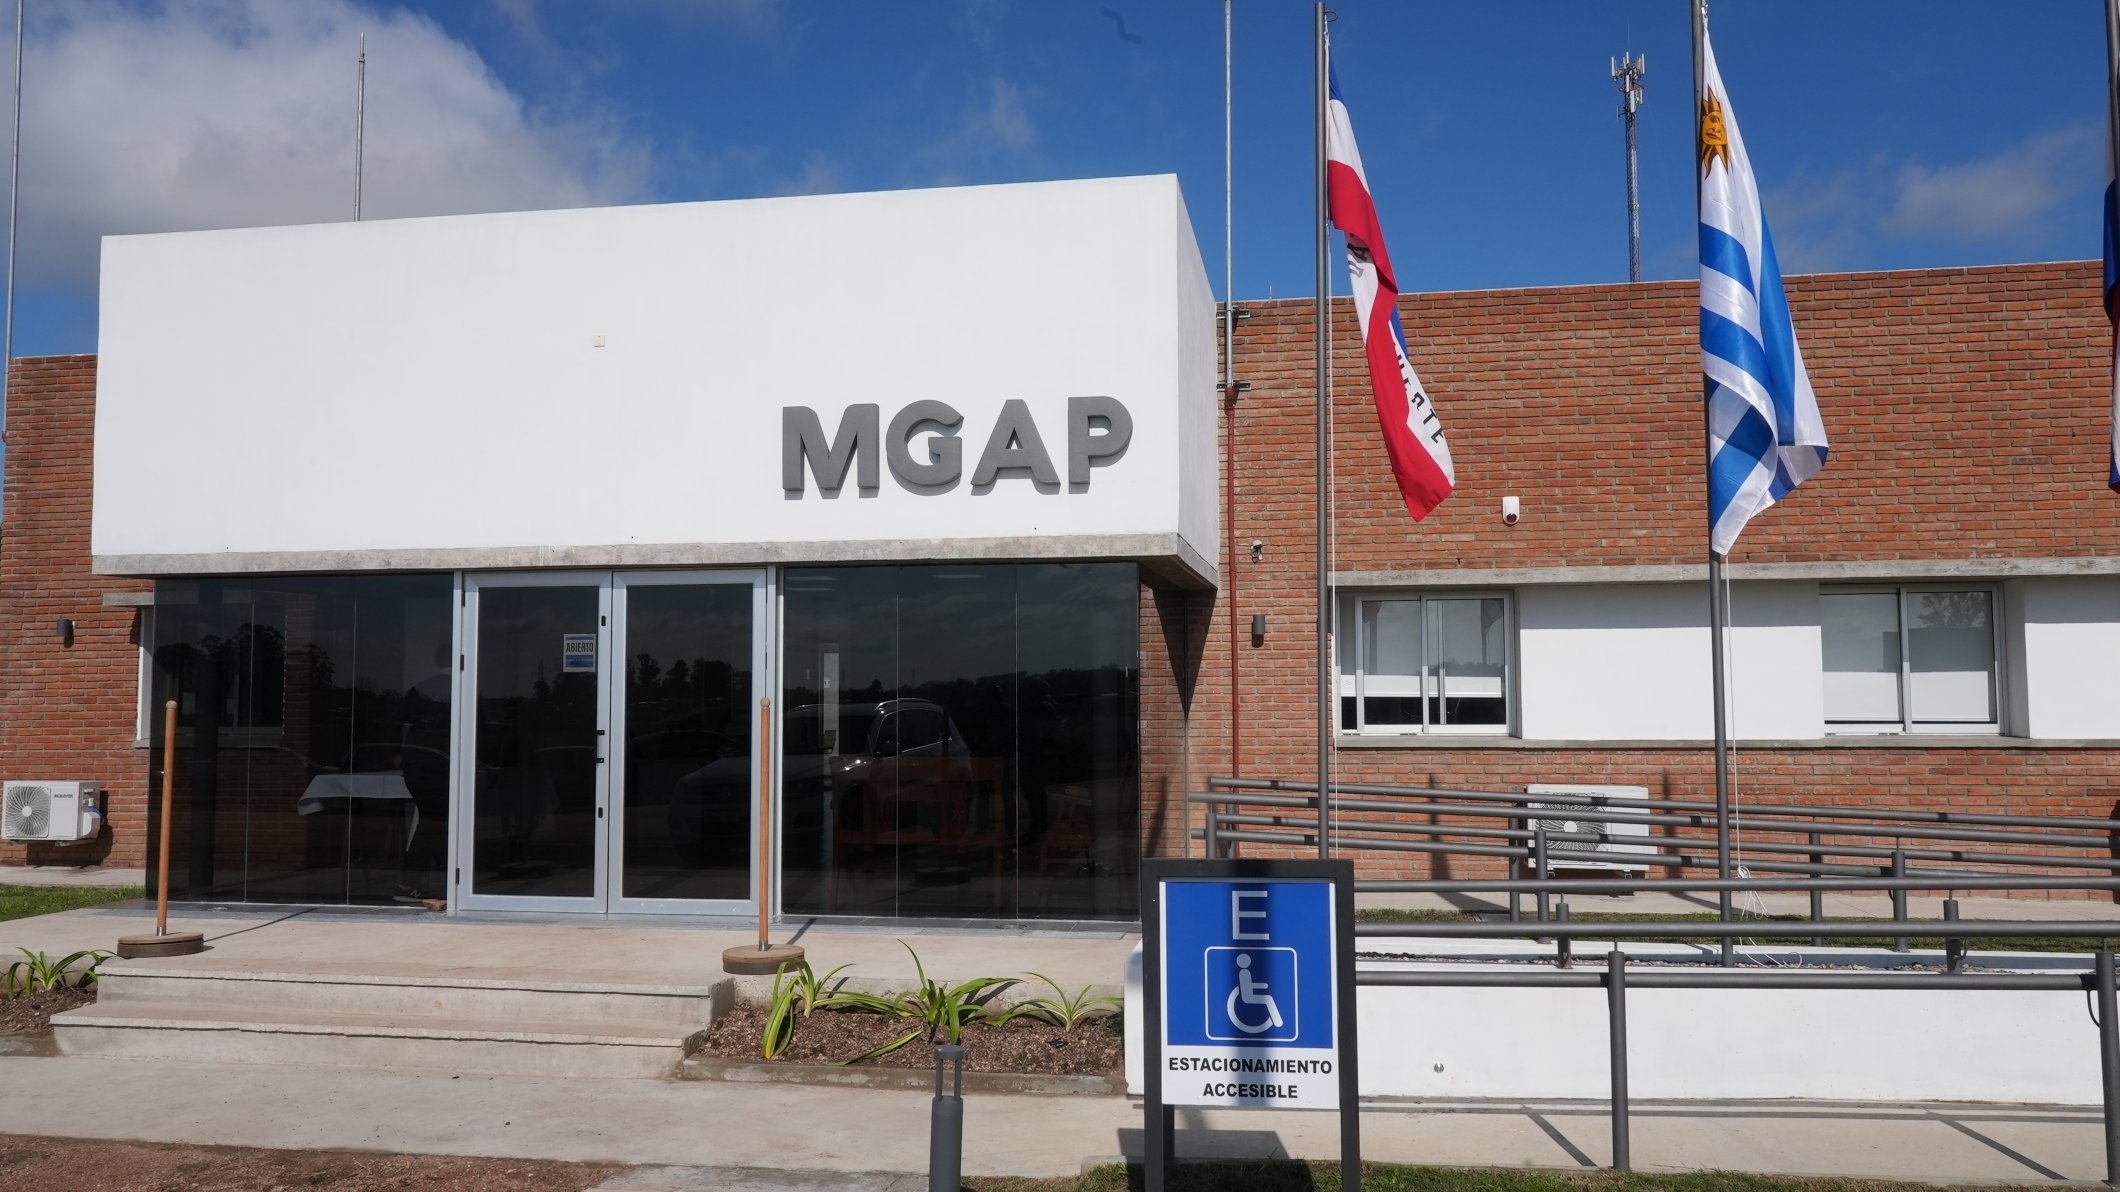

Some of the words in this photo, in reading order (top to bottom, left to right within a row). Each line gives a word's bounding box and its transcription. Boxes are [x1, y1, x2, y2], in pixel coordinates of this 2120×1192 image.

[782, 395, 1134, 500] MGAP
[566, 642, 594, 653] ABIERTO
[1231, 890, 1270, 941] E
[1169, 1057, 1333, 1075] ESTACIONAMIENTO
[1202, 1082, 1298, 1099] ACCESIBLE
